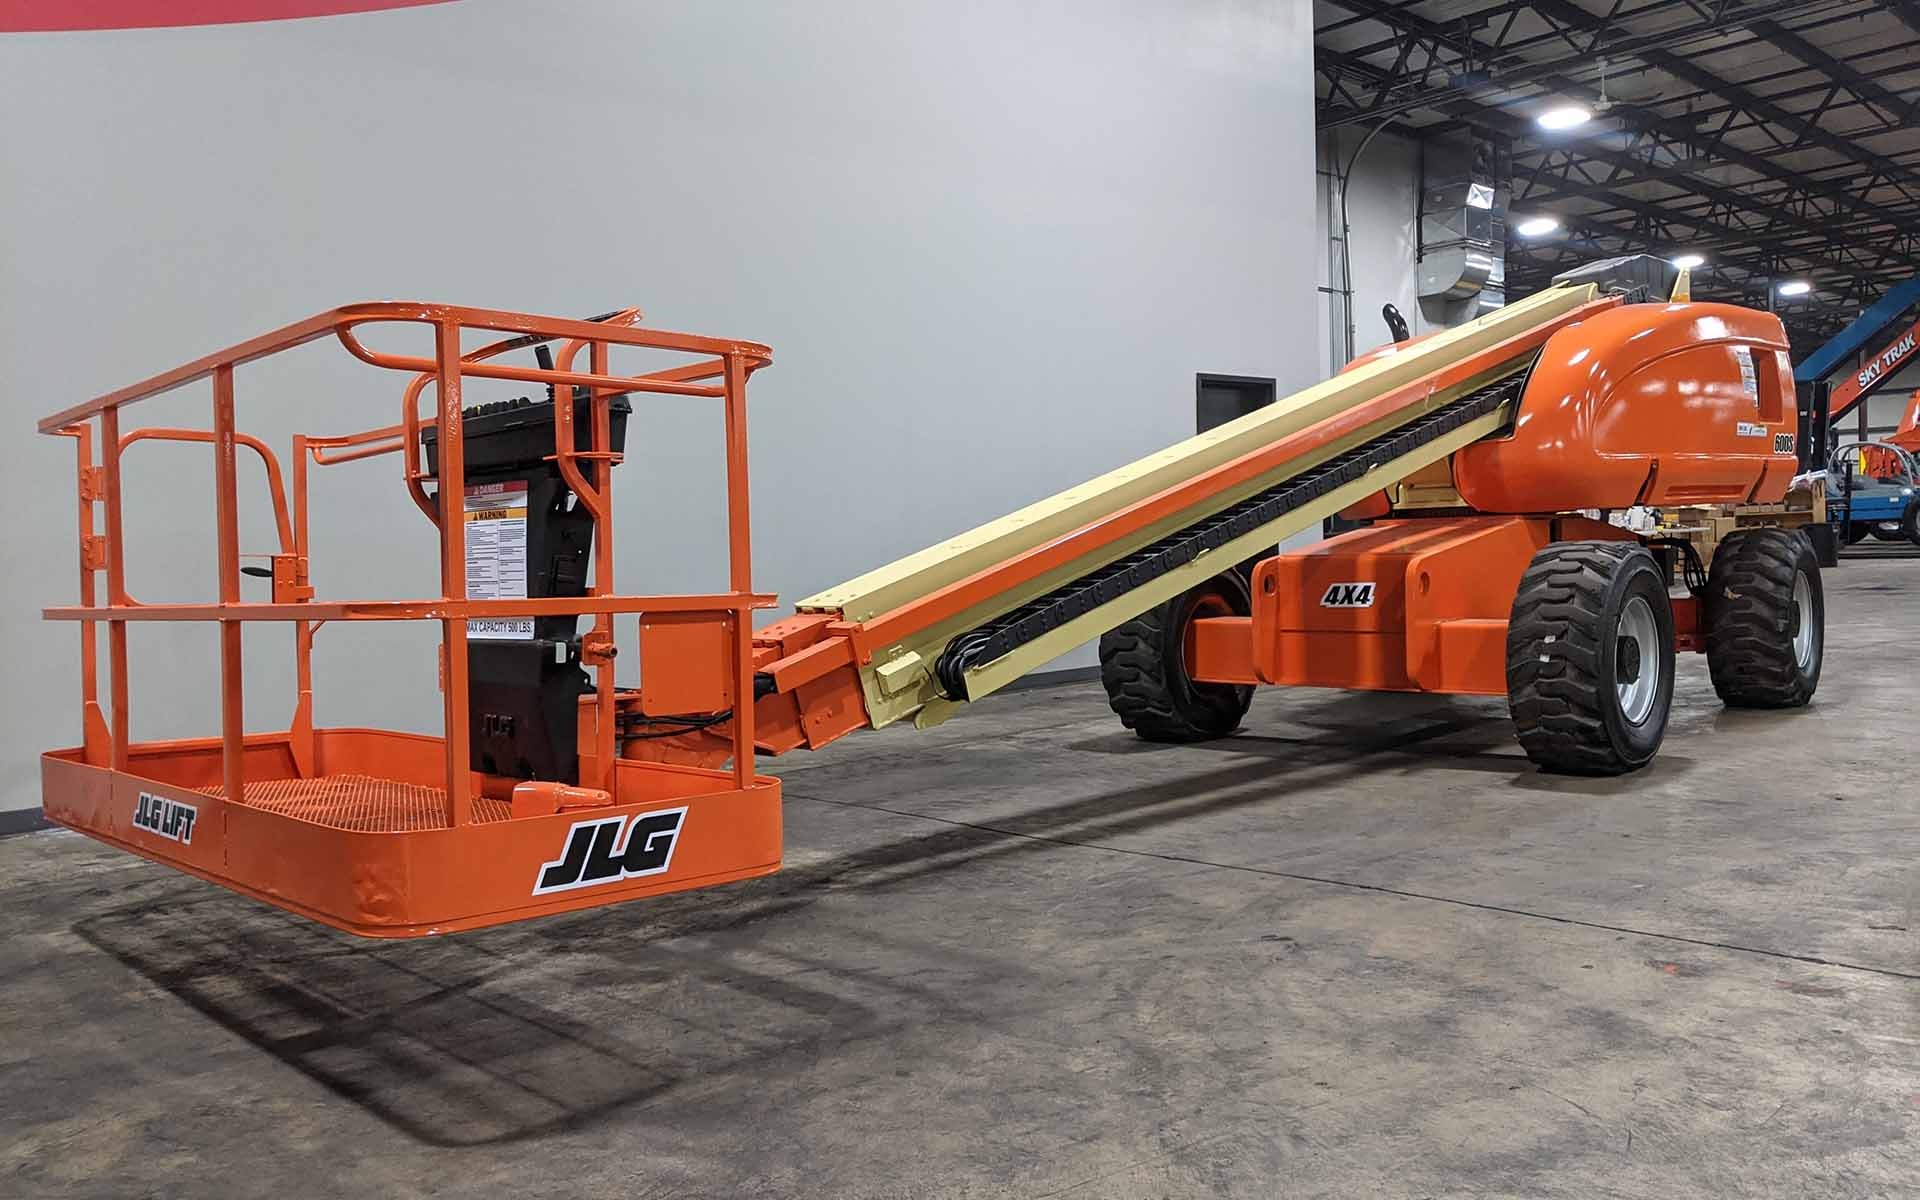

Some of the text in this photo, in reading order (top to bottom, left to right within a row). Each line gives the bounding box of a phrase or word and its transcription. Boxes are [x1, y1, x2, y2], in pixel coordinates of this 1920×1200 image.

[1858, 333, 1916, 387] SKY TRAK
[1774, 434, 1794, 453] 600S
[478, 510, 508, 521] WARNING
[1323, 584, 1373, 605] 4X4
[480, 622, 507, 633] CAPACITY
[508, 622, 519, 633] 500
[535, 808, 687, 893] JLG
